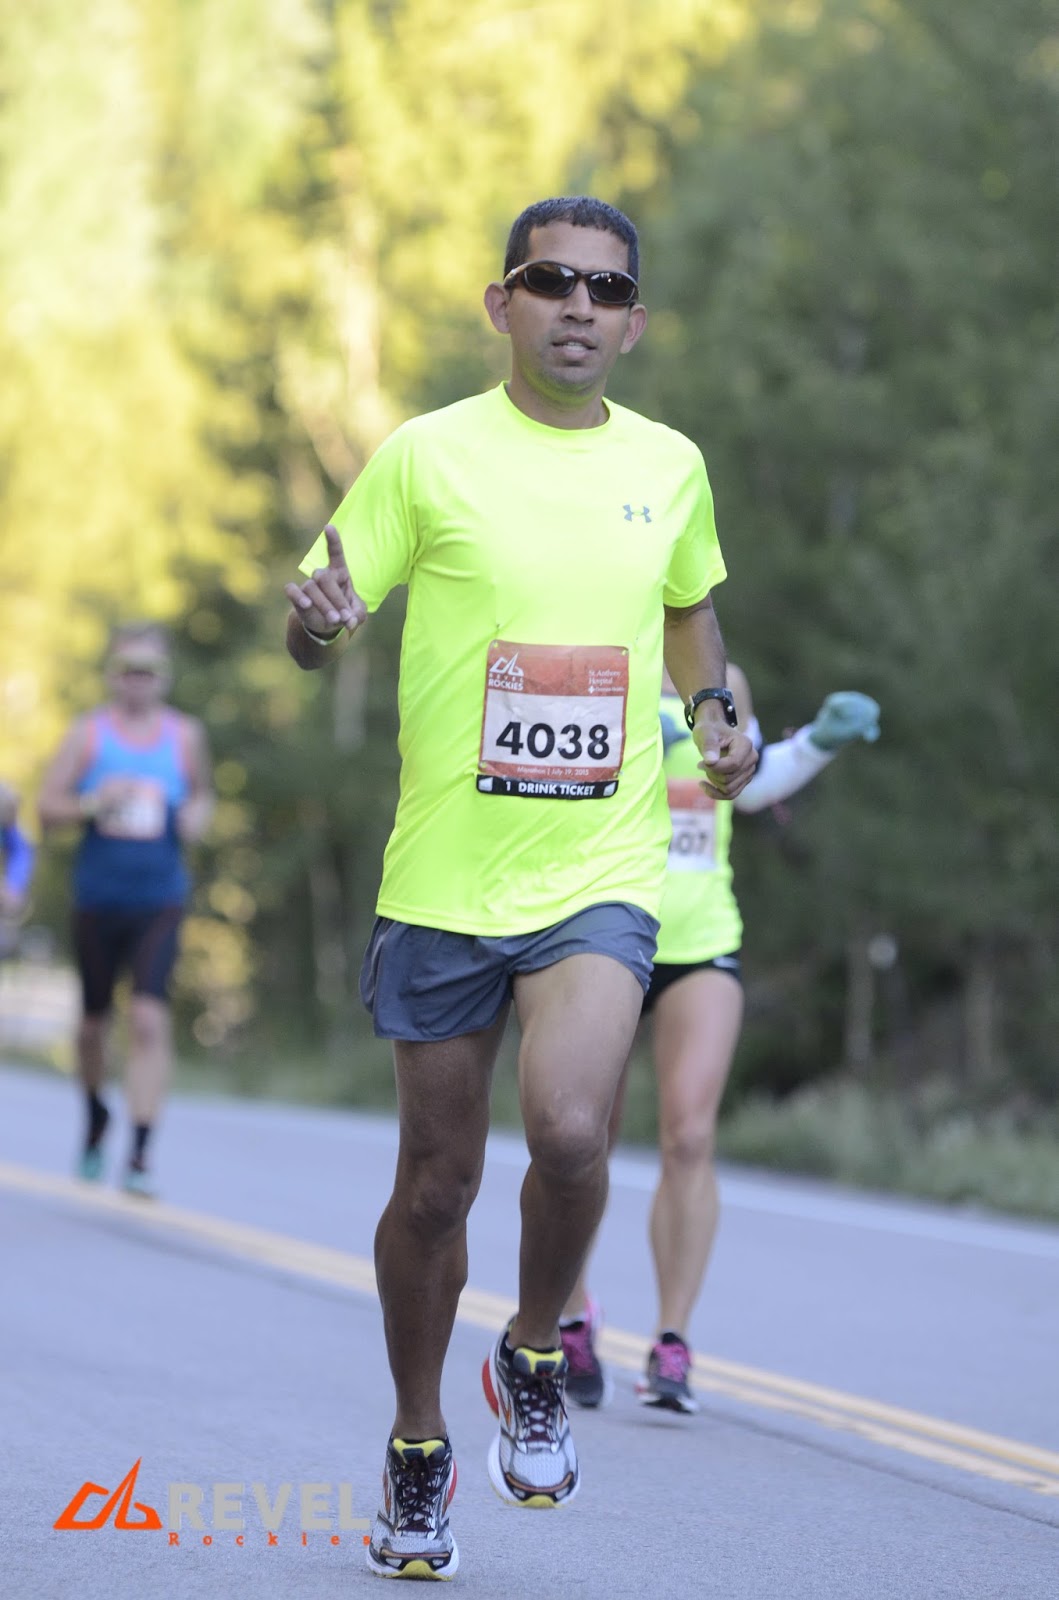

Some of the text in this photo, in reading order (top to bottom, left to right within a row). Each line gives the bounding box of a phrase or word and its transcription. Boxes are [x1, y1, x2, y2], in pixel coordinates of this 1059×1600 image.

[488, 679, 524, 691] ROCKIES
[496, 721, 610, 760] 4038
[505, 781, 595, 796] 1 DRINK TICKET
